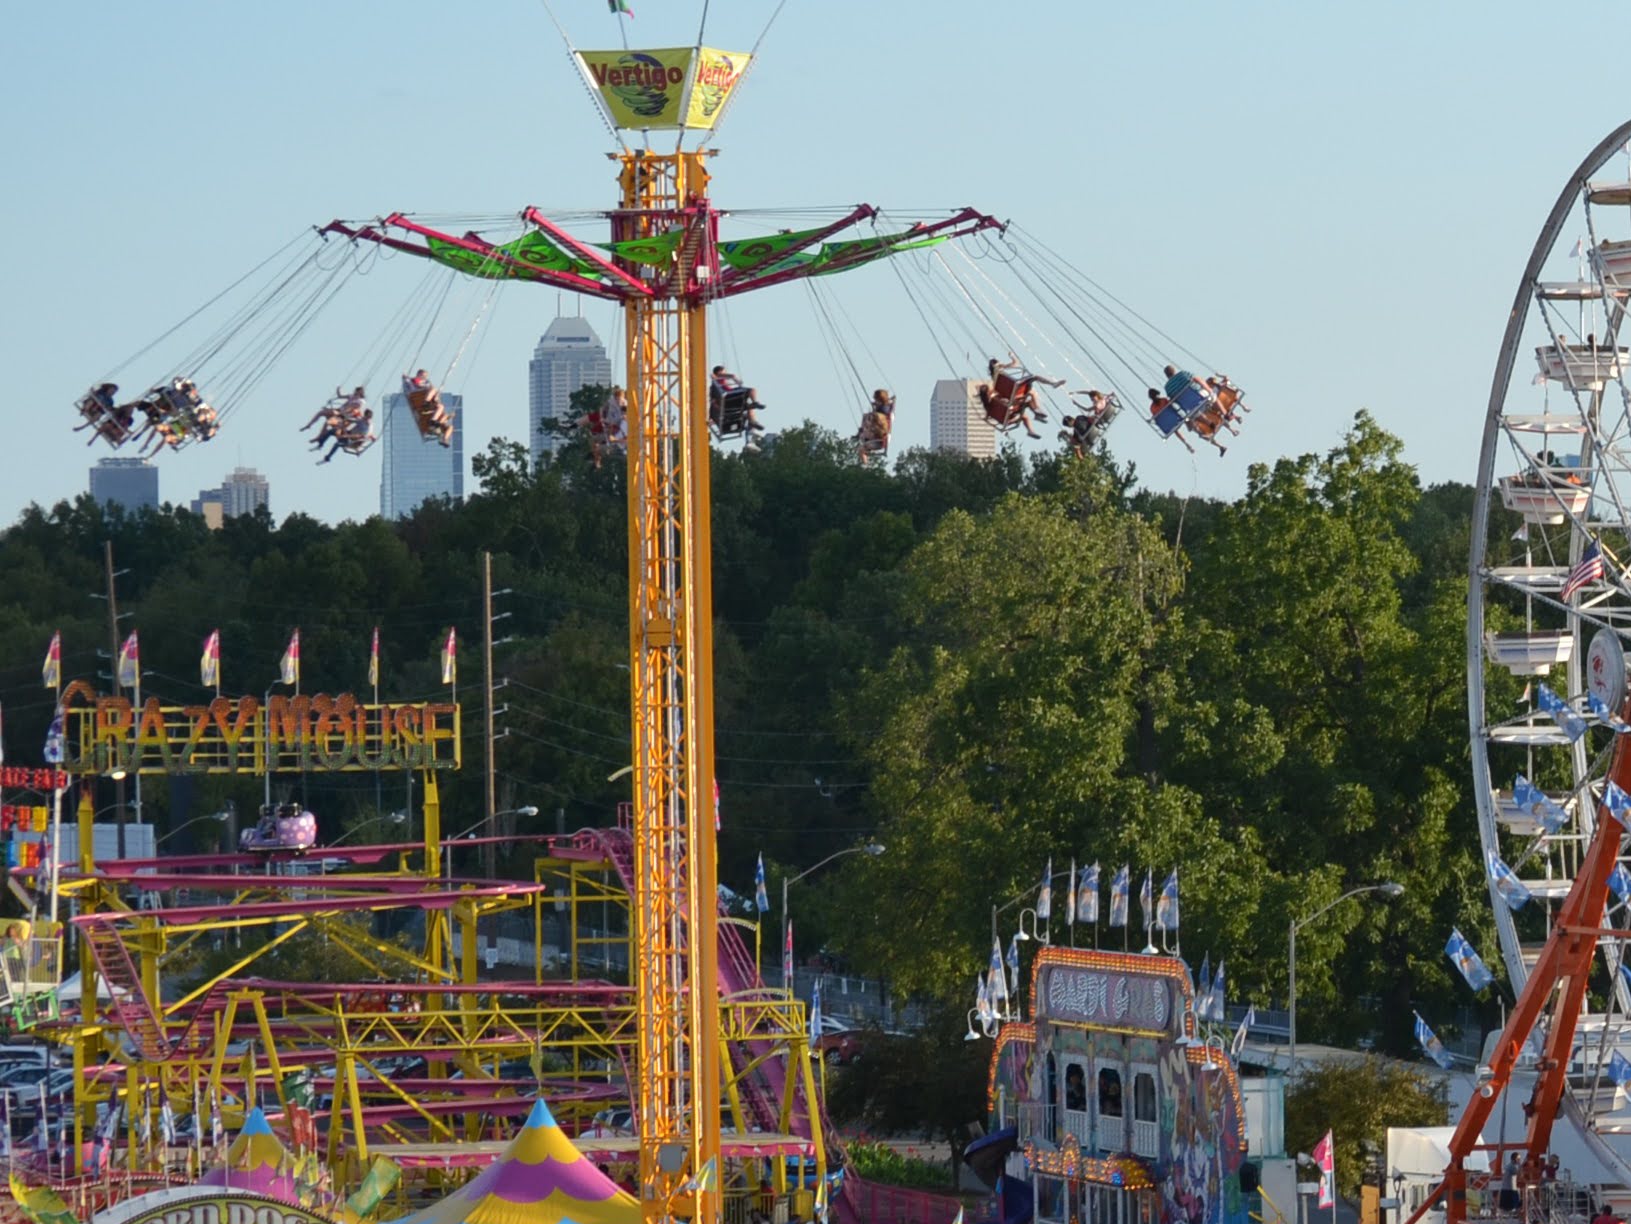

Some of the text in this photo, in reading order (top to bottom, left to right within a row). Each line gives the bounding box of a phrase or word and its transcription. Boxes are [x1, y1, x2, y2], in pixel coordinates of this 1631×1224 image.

[590, 62, 683, 92] Vertigo
[60, 679, 458, 775] CRAZY MOUSE
